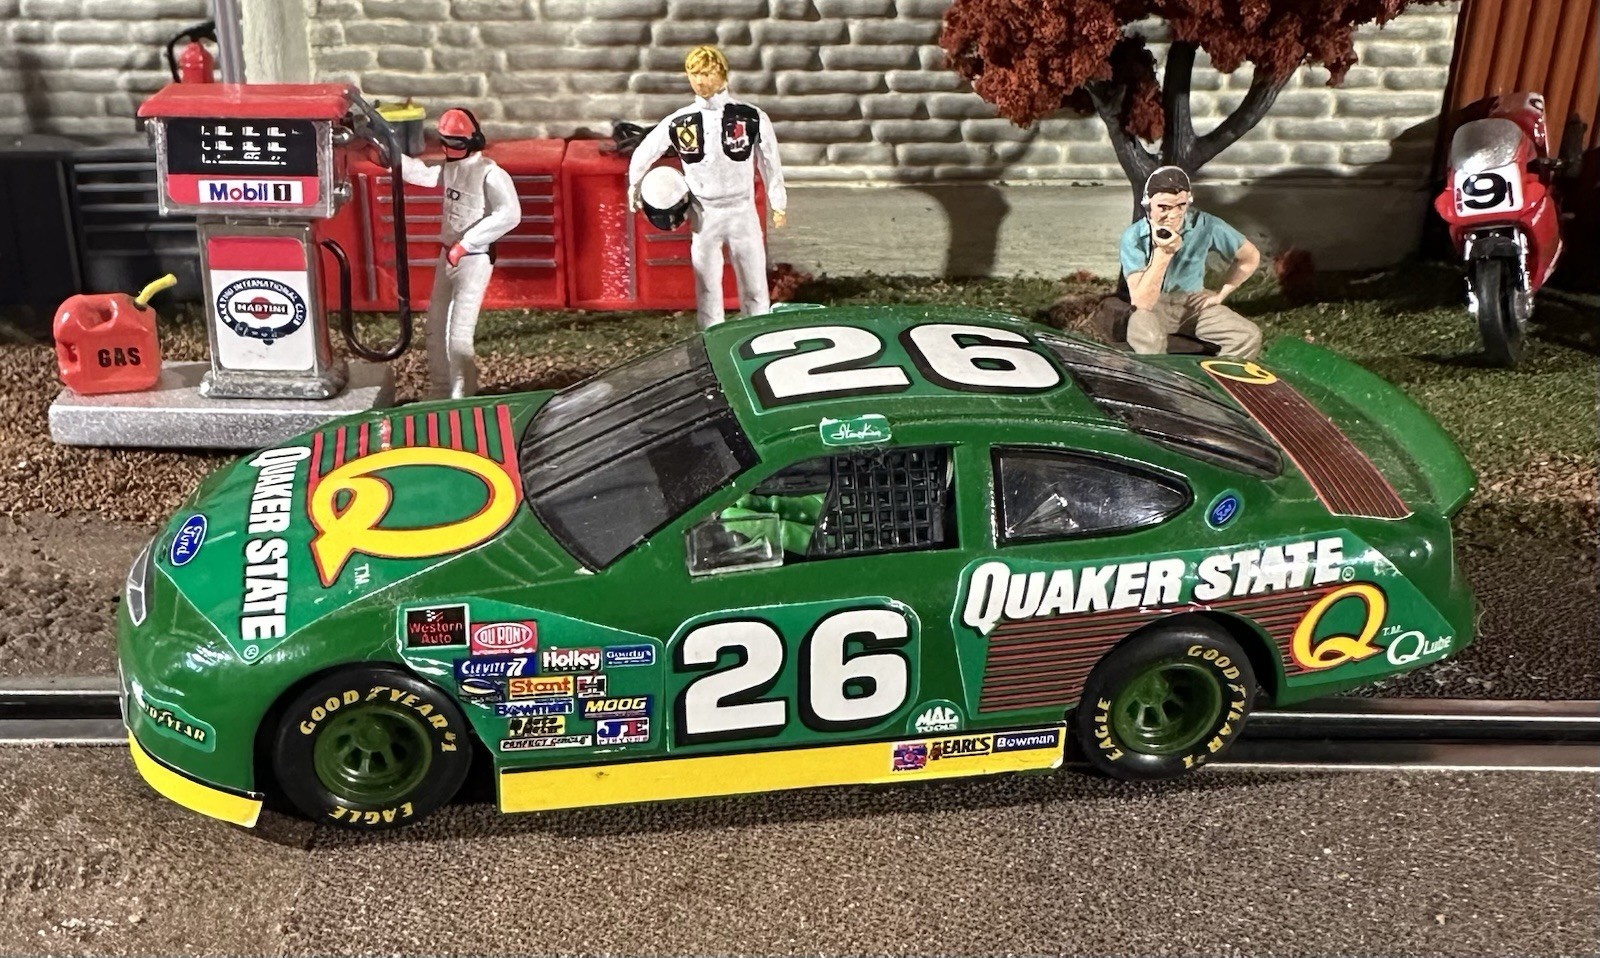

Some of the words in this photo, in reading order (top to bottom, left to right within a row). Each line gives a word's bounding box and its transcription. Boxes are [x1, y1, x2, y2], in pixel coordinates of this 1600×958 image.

[210, 183, 268, 201] Mobil
[273, 183, 291, 201] 1
[1462, 172, 1508, 209] 9
[237, 303, 286, 313] MARTINI
[97, 347, 142, 367] GAS
[739, 323, 1066, 408] 26
[249, 446, 311, 534] QUAKER
[308, 446, 522, 588] Q
[175, 525, 204, 556] Ford
[241, 538, 288, 640] STATE
[963, 561, 1187, 636] QUAKER
[1195, 536, 1344, 602] STATE
[409, 622, 463, 634] Western
[1291, 582, 1389, 673] Q
[421, 634, 452, 644] Auto
[506, 657, 528, 677] 77
[542, 650, 600, 671] Holley
[511, 677, 571, 693] Stant
[673, 603, 913, 747] 26
[584, 697, 648, 713] MOOG
[914, 706, 959, 726] MAC
[1094, 697, 1124, 762] EAGLE
[996, 735, 1055, 748] Bowman
[328, 802, 414, 825] EAGLE
